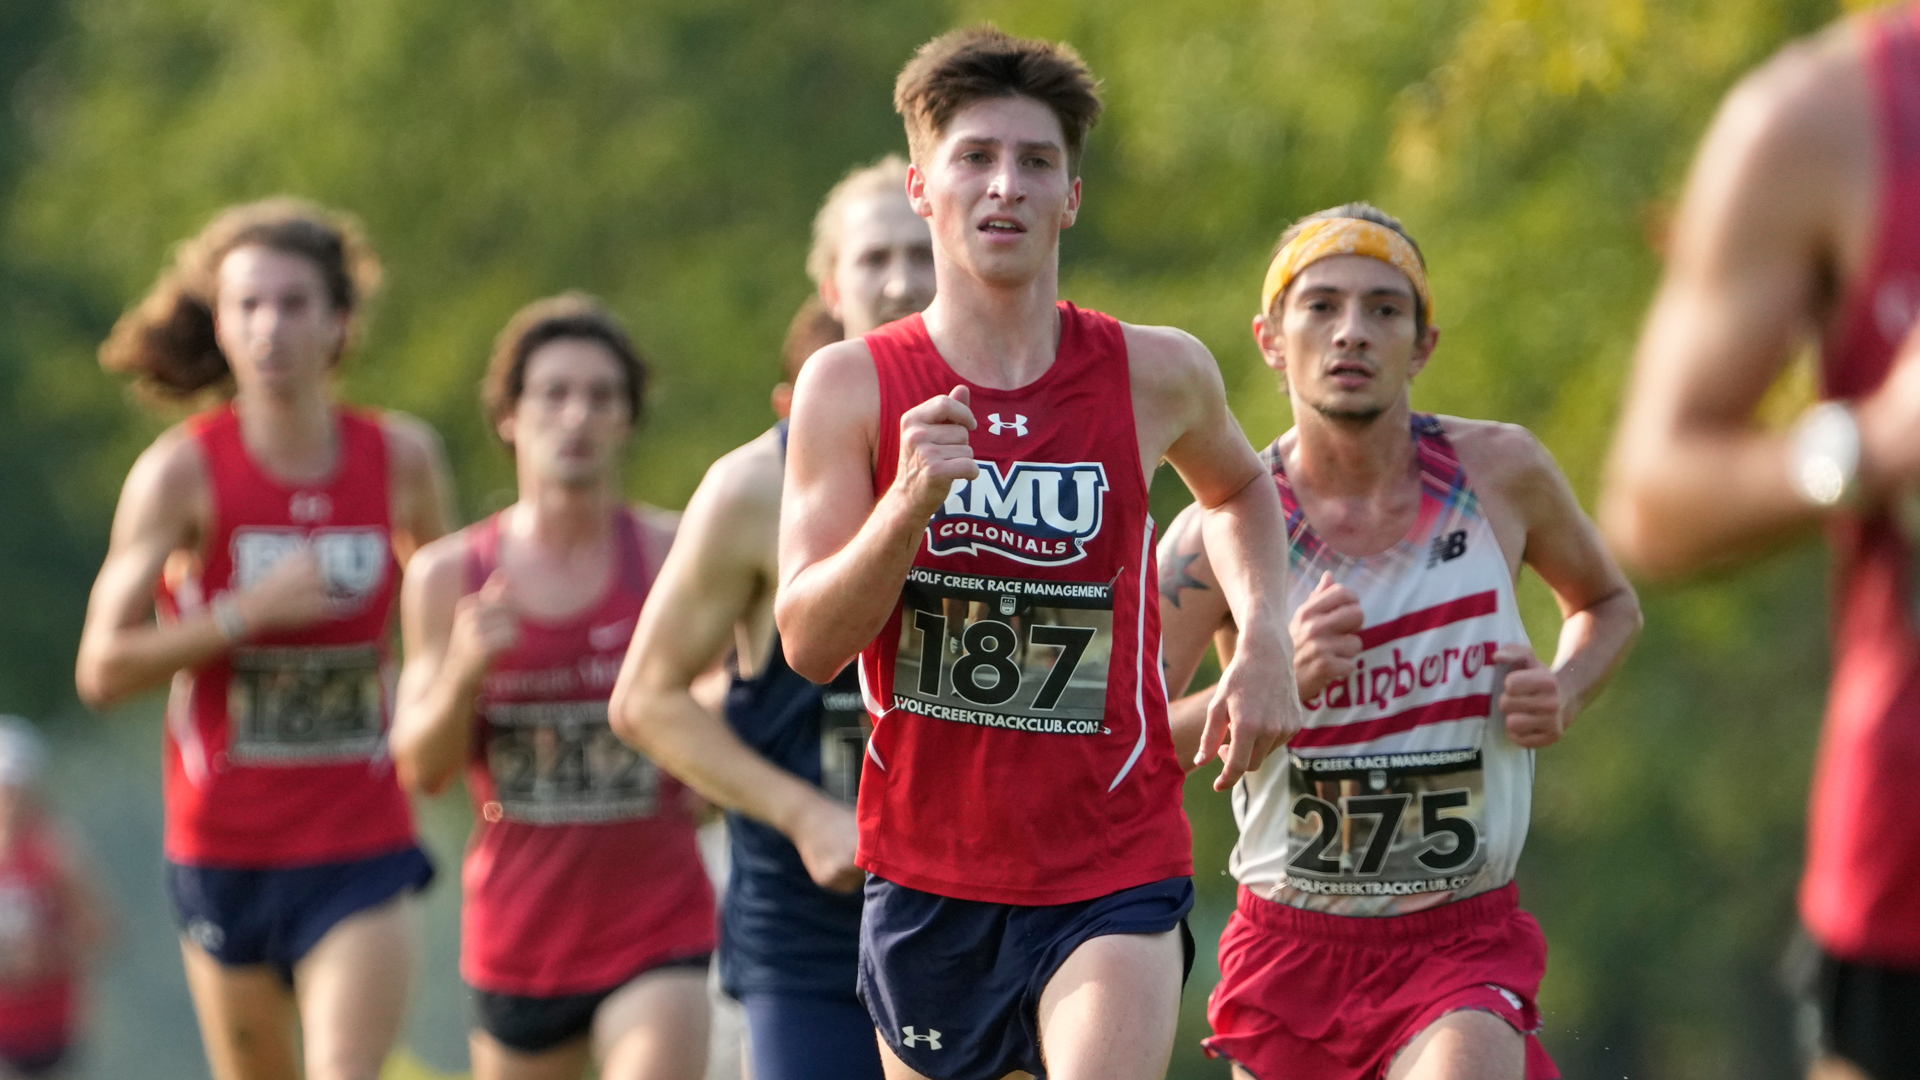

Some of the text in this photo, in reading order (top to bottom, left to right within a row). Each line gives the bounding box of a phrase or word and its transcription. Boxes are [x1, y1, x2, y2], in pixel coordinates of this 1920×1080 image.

[939, 521, 1067, 555] COLONIALS
[943, 575, 985, 591] CREEK
[987, 580, 1021, 594] RACE
[1024, 582, 1109, 598] MANAGEMENT
[913, 608, 1098, 712] 187
[1312, 757, 1354, 772] CREEK
[1354, 755, 1389, 770] RACE
[1390, 749, 1479, 769] MANAGEMENT
[1285, 787, 1480, 877] 275
